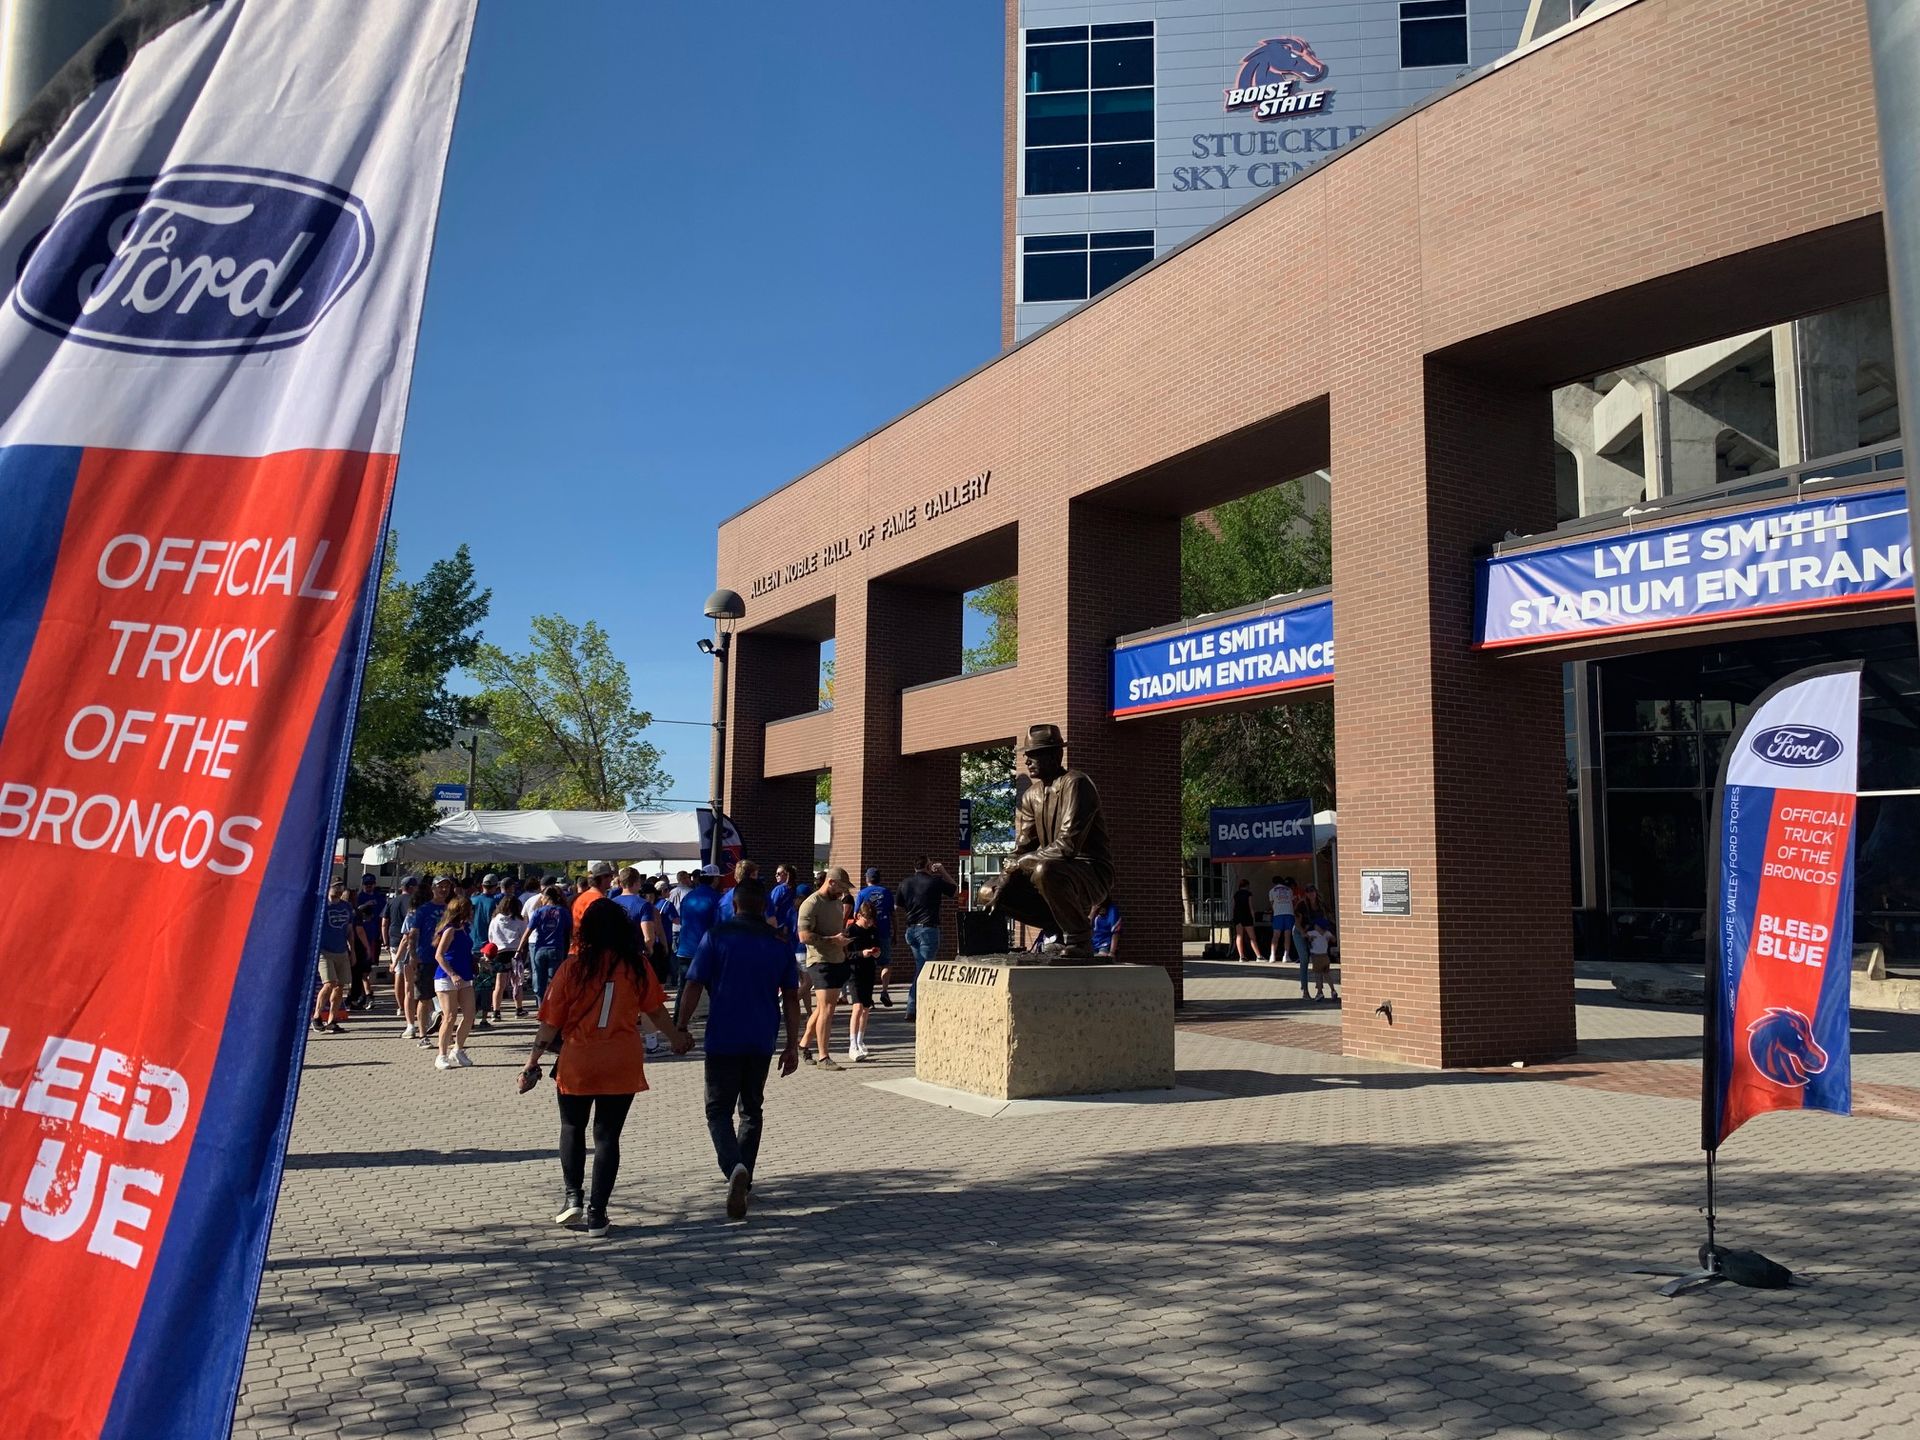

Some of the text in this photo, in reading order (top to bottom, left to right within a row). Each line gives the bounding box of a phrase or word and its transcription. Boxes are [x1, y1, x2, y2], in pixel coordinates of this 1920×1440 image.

[1228, 80, 1292, 106] BOISE
[1257, 92, 1325, 117] STATE
[1173, 164, 1239, 192] SKY
[78, 198, 315, 318] Ford
[750, 470, 991, 599] ALLEN NOBLE HALL OF FAME GALLERY
[1594, 504, 1848, 579] LYLE SMITH
[97, 533, 338, 601] OFFICIAL
[1509, 576, 1684, 629] STADIUM
[108, 620, 276, 688] TRUCK
[1169, 619, 1285, 666] LYLE SMITH
[1129, 640, 1334, 701] STADIUM ENTRANCE
[64, 705, 248, 779] OF THE
[1767, 730, 1825, 761] Ford
[0, 782, 263, 876] BRONCOS
[1218, 819, 1304, 840] BAG CHECK
[1729, 786, 1740, 833] STORES
[1780, 807, 1847, 826] OFFICIAL
[1729, 838, 1738, 868] FORD
[1777, 846, 1831, 865] OF THE
[1783, 826, 1835, 845] TRUCK
[1726, 870, 1739, 914] VALLEY
[1763, 863, 1837, 885] BRONCOS
[1726, 916, 1735, 978] TREASURE
[1759, 914, 1828, 943] BLEED
[1756, 935, 1825, 967] BLUE
[929, 963, 999, 987] LYLE SMITH
[597, 981, 614, 1028] 1
